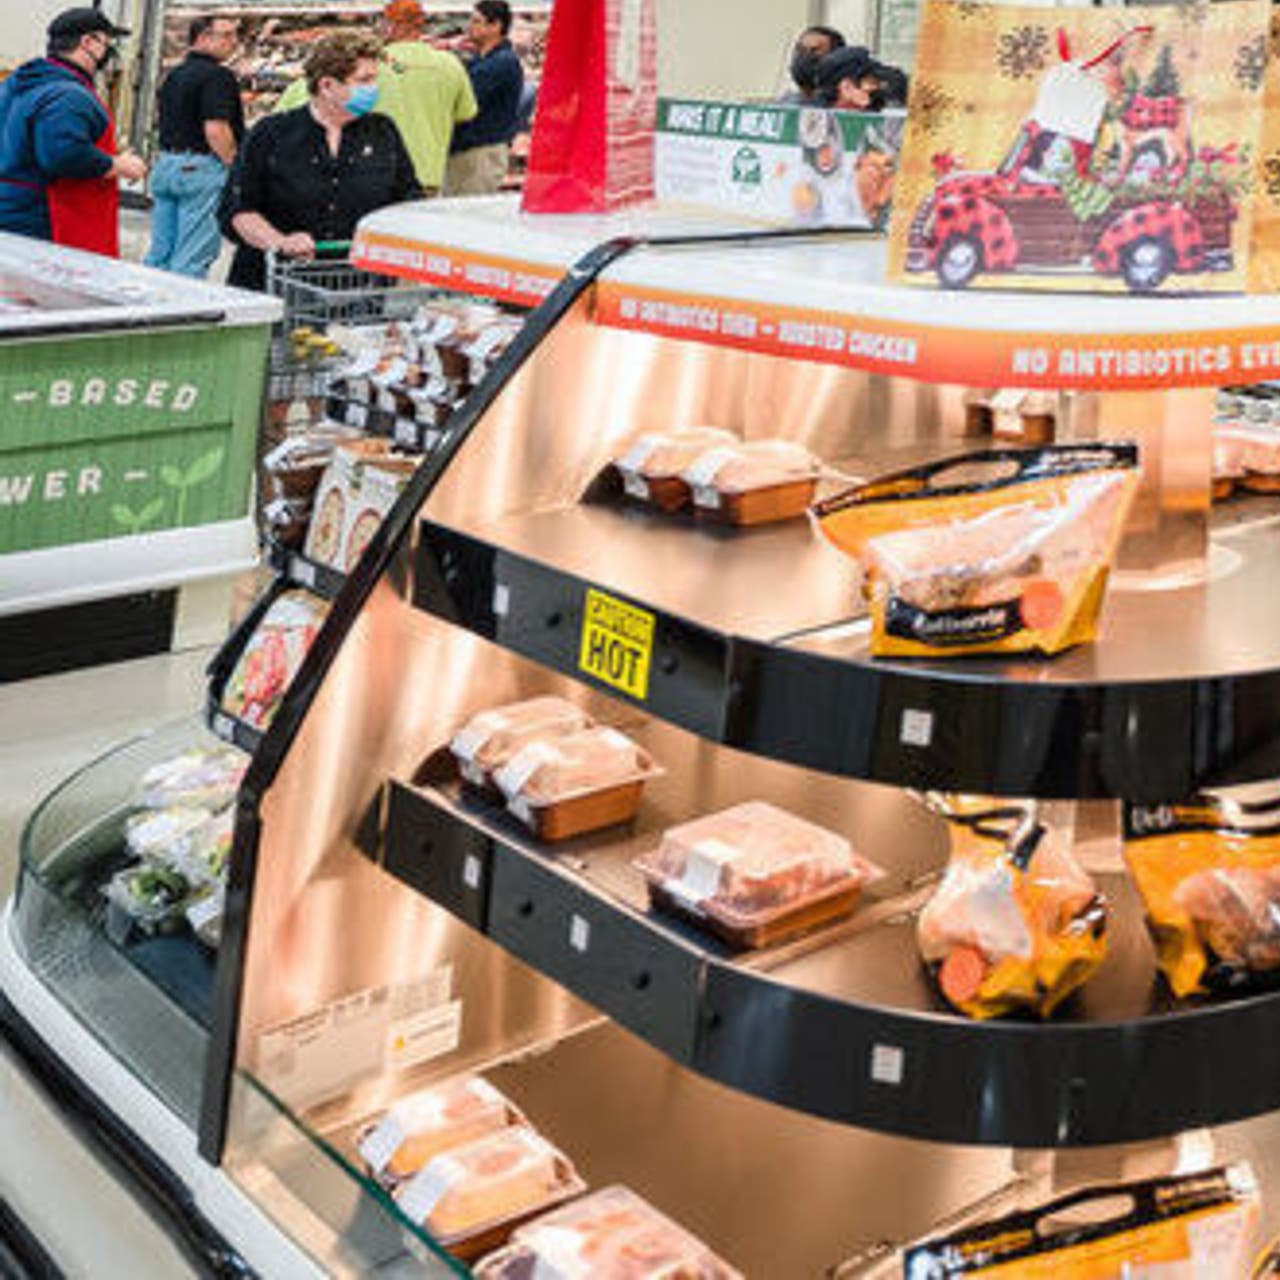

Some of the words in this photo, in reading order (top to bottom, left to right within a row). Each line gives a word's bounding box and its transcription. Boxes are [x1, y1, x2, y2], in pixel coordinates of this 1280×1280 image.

[1012, 347, 1048, 374] NO
[1058, 344, 1230, 377] ANTIBIOTICS
[587, 629, 641, 687] HOT
